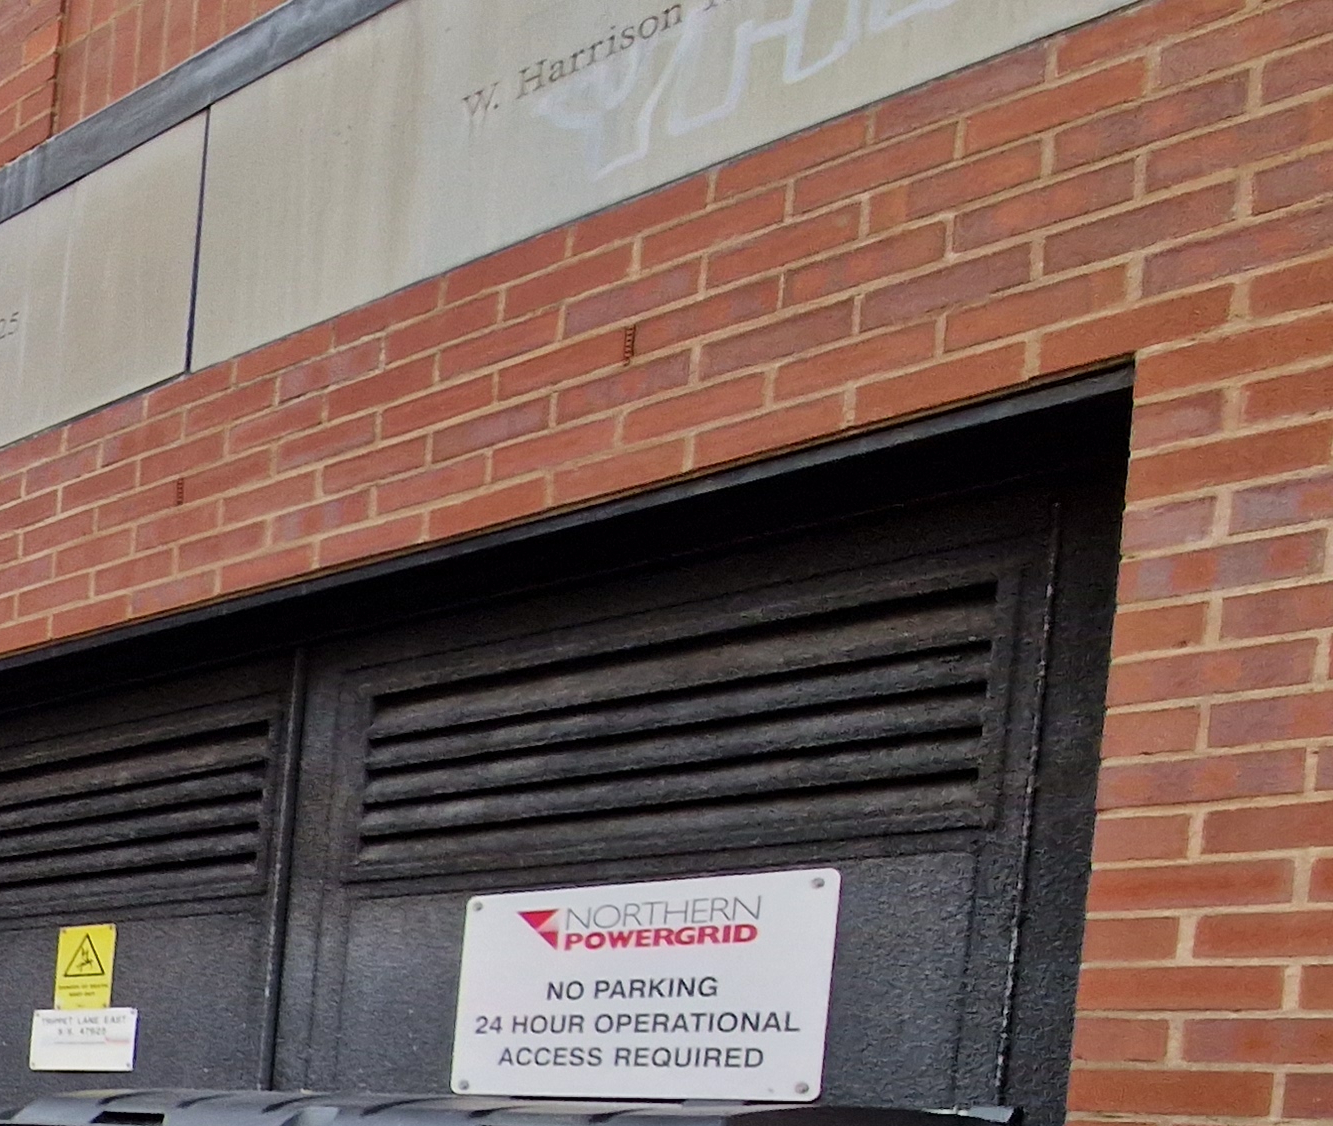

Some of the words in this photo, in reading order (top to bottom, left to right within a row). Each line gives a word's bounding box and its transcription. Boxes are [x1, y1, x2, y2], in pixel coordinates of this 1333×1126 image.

[459, 88, 501, 121] W.
[517, 2, 683, 99] Harrison
[564, 895, 763, 931] NORTHERN
[563, 924, 759, 951] POWERGRID
[546, 980, 585, 1001] NO
[593, 976, 719, 999] PARKING
[475, 1015, 503, 1034] 24
[511, 1014, 585, 1034] HOUR
[594, 1011, 801, 1034] OPERATIONAL
[498, 1047, 602, 1067] ACCESS
[614, 1046, 764, 1069] REQUIRED
